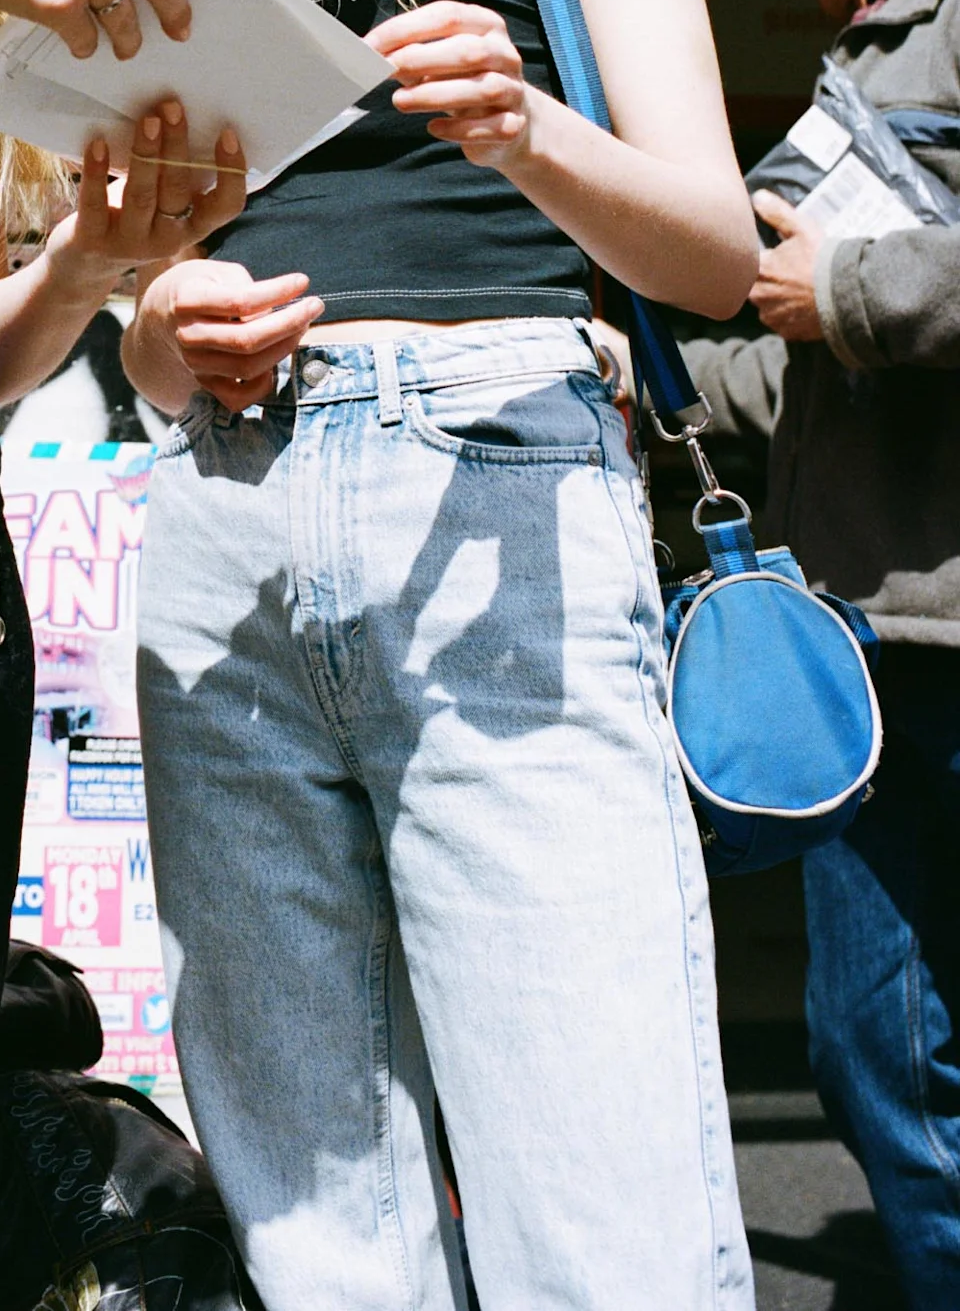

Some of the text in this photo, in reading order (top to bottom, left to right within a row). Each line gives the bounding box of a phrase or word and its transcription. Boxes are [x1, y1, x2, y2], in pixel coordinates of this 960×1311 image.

[48, 846, 123, 866] MONDAY
[49, 864, 117, 928] 18th
[60, 928, 102, 947] APRIL
